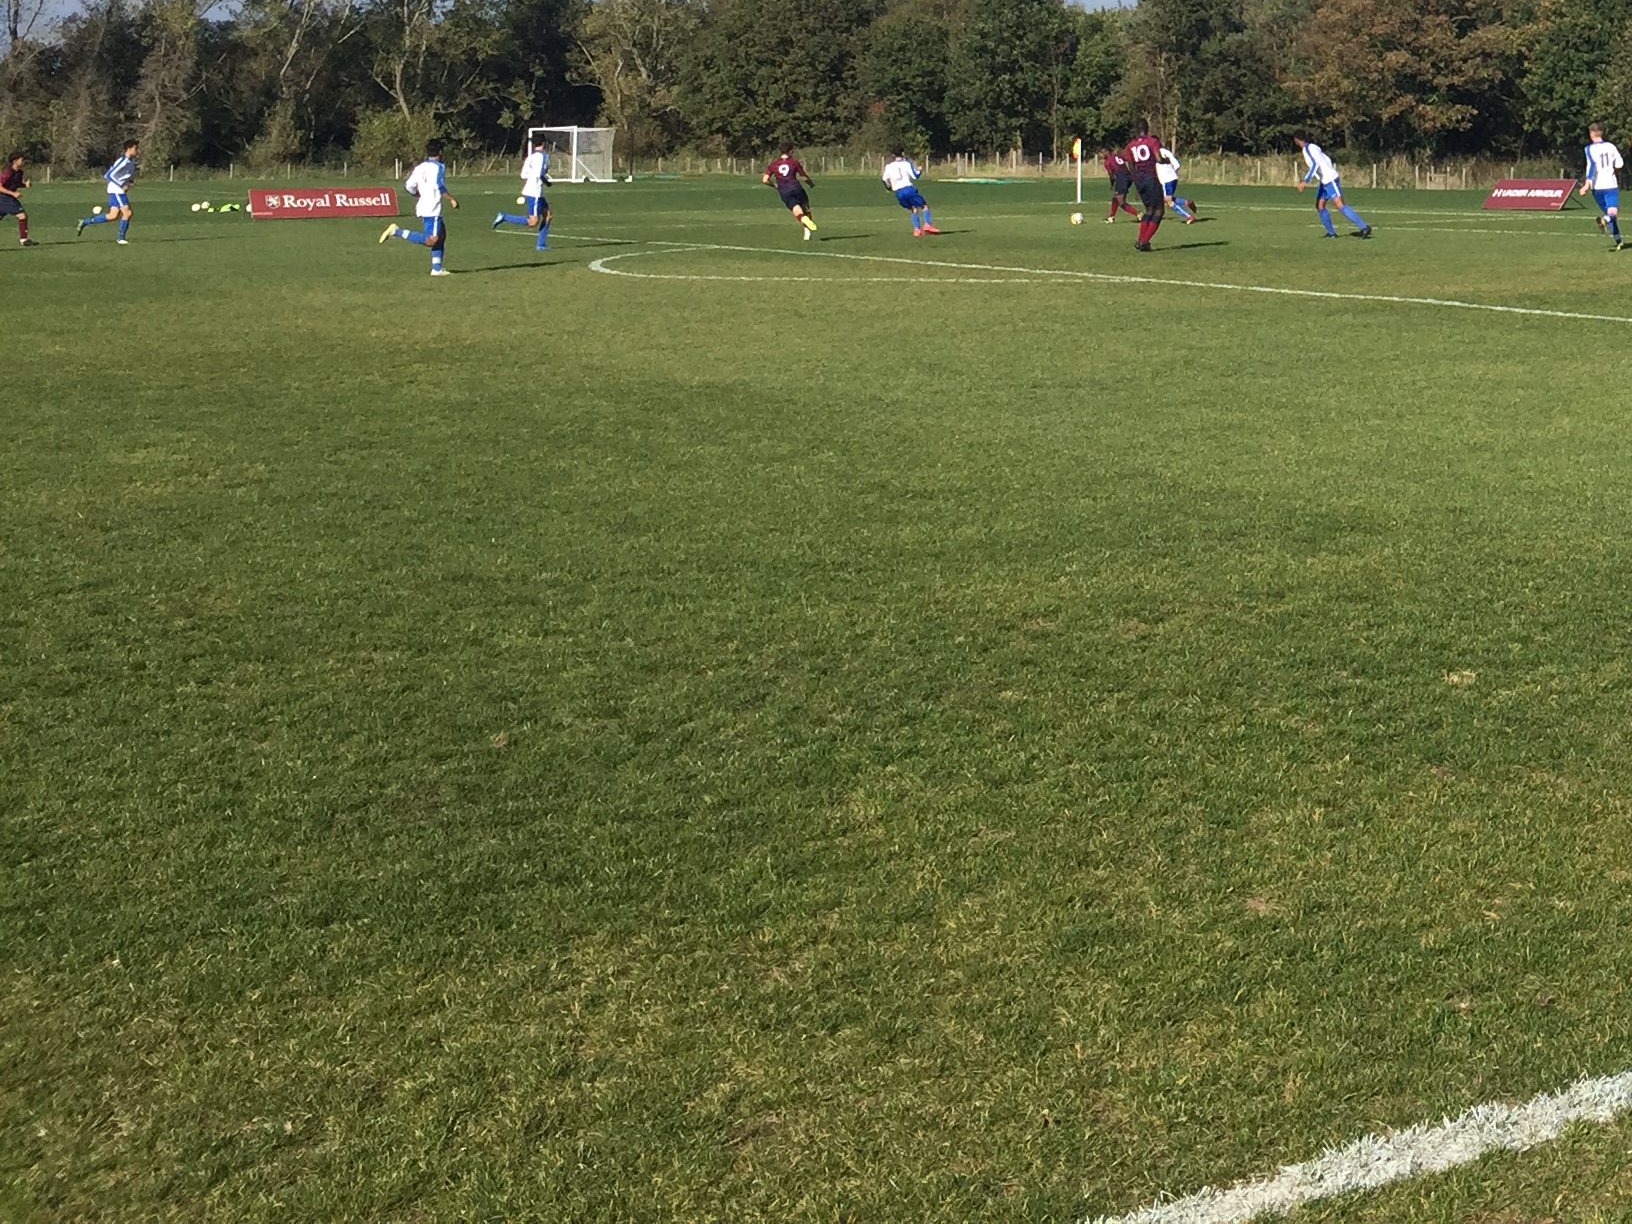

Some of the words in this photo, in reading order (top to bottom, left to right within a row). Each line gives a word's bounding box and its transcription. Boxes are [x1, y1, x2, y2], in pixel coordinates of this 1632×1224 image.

[1131, 144, 1151, 162] 10
[1599, 152, 1609, 168] 11
[778, 164, 790, 176] 9
[282, 194, 331, 211] Royal
[335, 193, 391, 208] Russell
